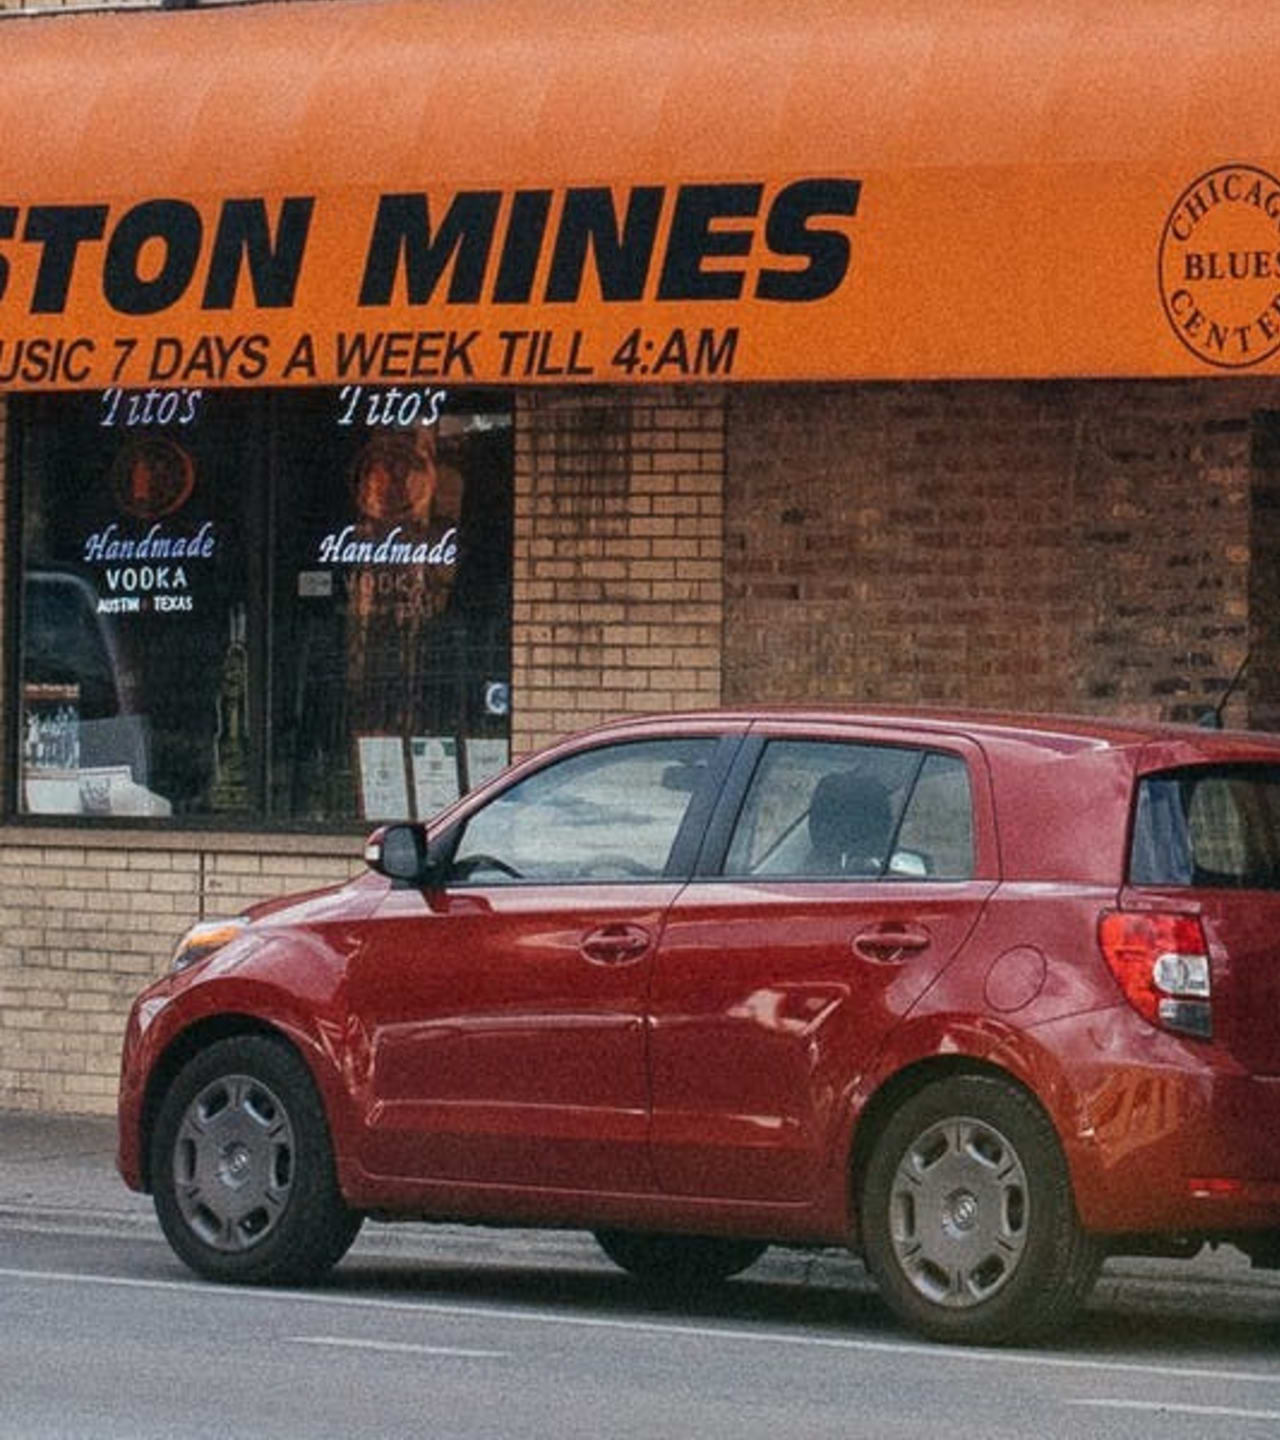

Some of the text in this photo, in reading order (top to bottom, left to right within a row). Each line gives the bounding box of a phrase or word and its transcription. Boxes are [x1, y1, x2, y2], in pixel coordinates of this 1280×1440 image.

[0, 177, 862, 317] TON MINES
[111, 337, 138, 383] 7
[149, 333, 270, 382] DAYS
[281, 333, 316, 379] A
[334, 329, 482, 378] WEEK
[499, 329, 594, 377] TILL
[611, 326, 740, 375] 4:AM
[83, 521, 215, 562] Handmade
[318, 525, 458, 565] Handmade
[106, 567, 188, 592] VODKA
[97, 595, 193, 614] AUSTIN TEXAS
